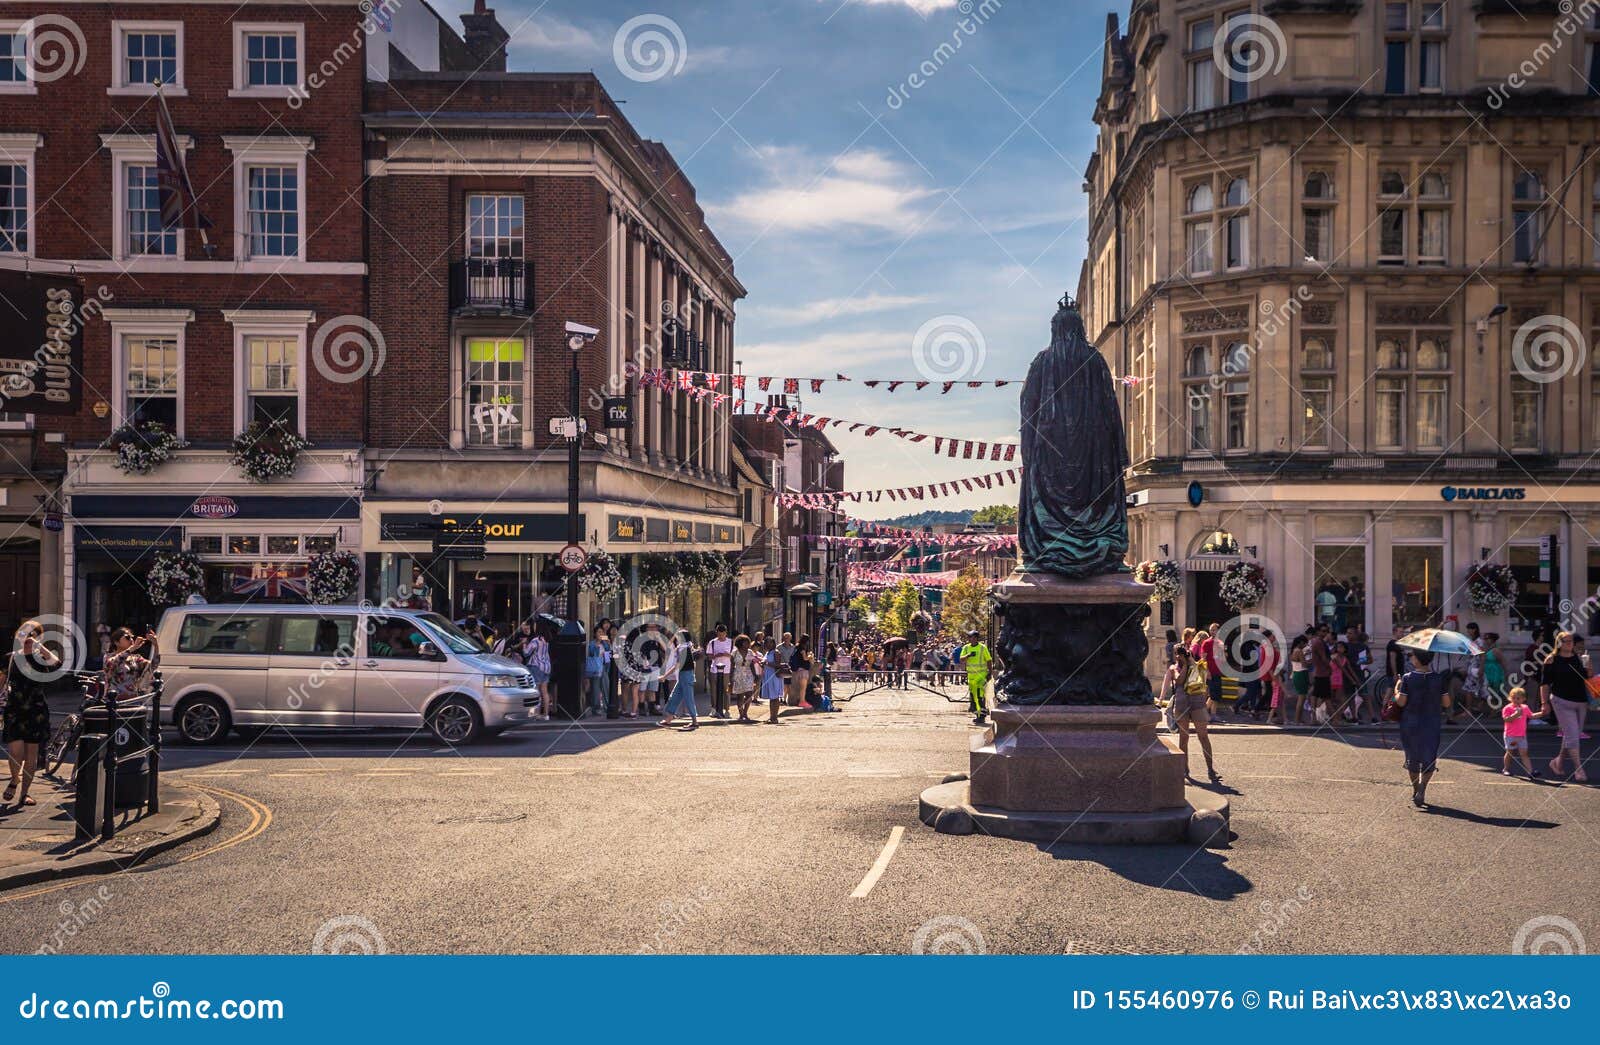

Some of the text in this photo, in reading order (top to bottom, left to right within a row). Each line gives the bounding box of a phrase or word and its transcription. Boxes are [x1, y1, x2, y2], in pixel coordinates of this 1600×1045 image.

[45, 288, 72, 402] BLUEGRASS
[473, 402, 519, 432] fix
[609, 406, 627, 419] fix
[1458, 488, 1526, 500] BARCLAYS
[193, 504, 236, 513] BRITAIN
